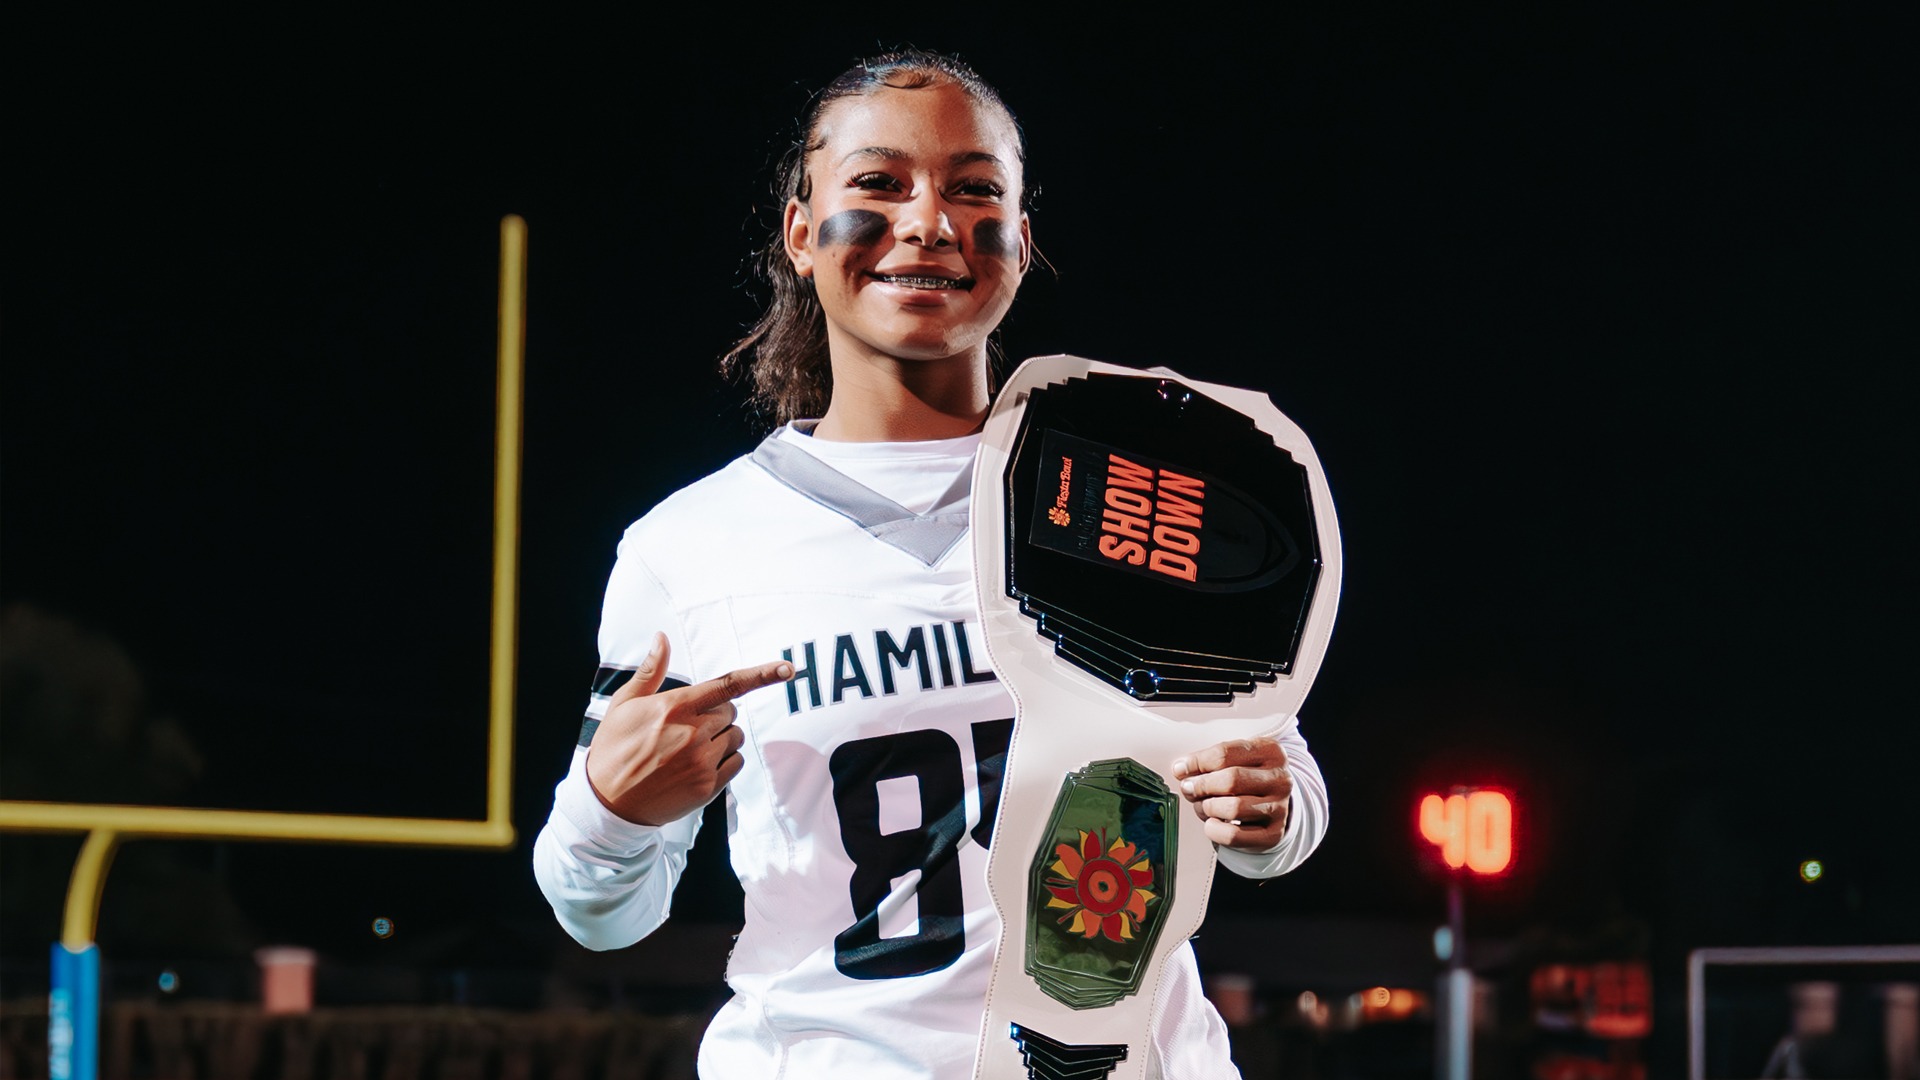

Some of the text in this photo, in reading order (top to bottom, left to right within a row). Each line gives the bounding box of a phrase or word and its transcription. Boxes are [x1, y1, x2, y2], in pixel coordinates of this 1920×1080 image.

[1099, 453, 1154, 566] SHOW
[1149, 469, 1205, 583] DOWN
[1420, 790, 1512, 873] 40
